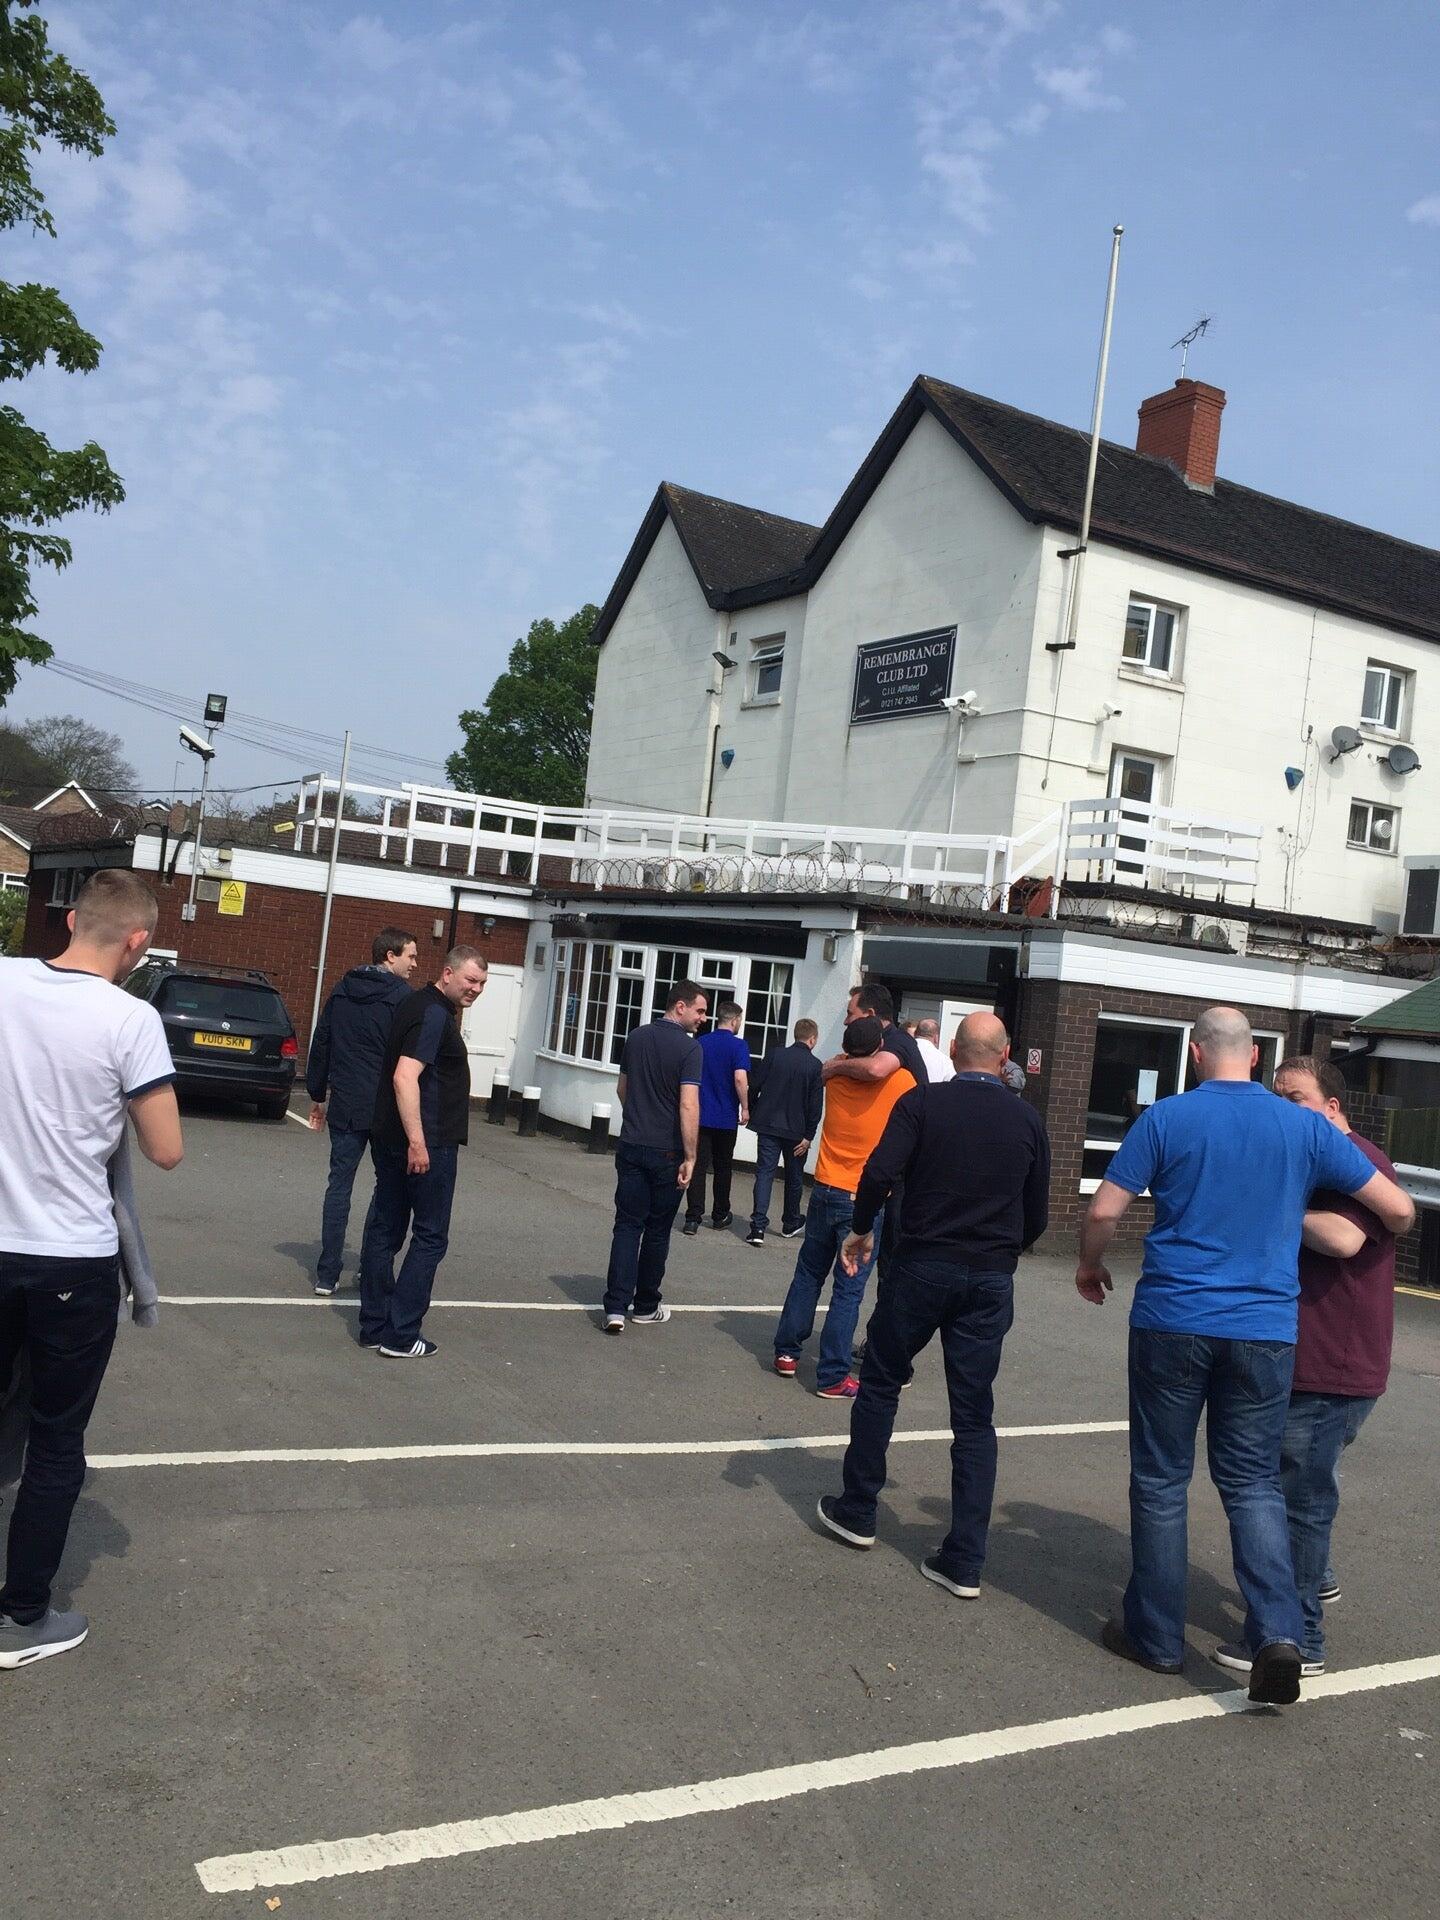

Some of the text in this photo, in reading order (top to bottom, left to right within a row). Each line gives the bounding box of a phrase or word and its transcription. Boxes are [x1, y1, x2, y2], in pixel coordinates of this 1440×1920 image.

[863, 642, 948, 670] REMEMBRANCE
[876, 664, 928, 684] CLUB LTD
[201, 1033, 246, 1048] VU10 SKN
